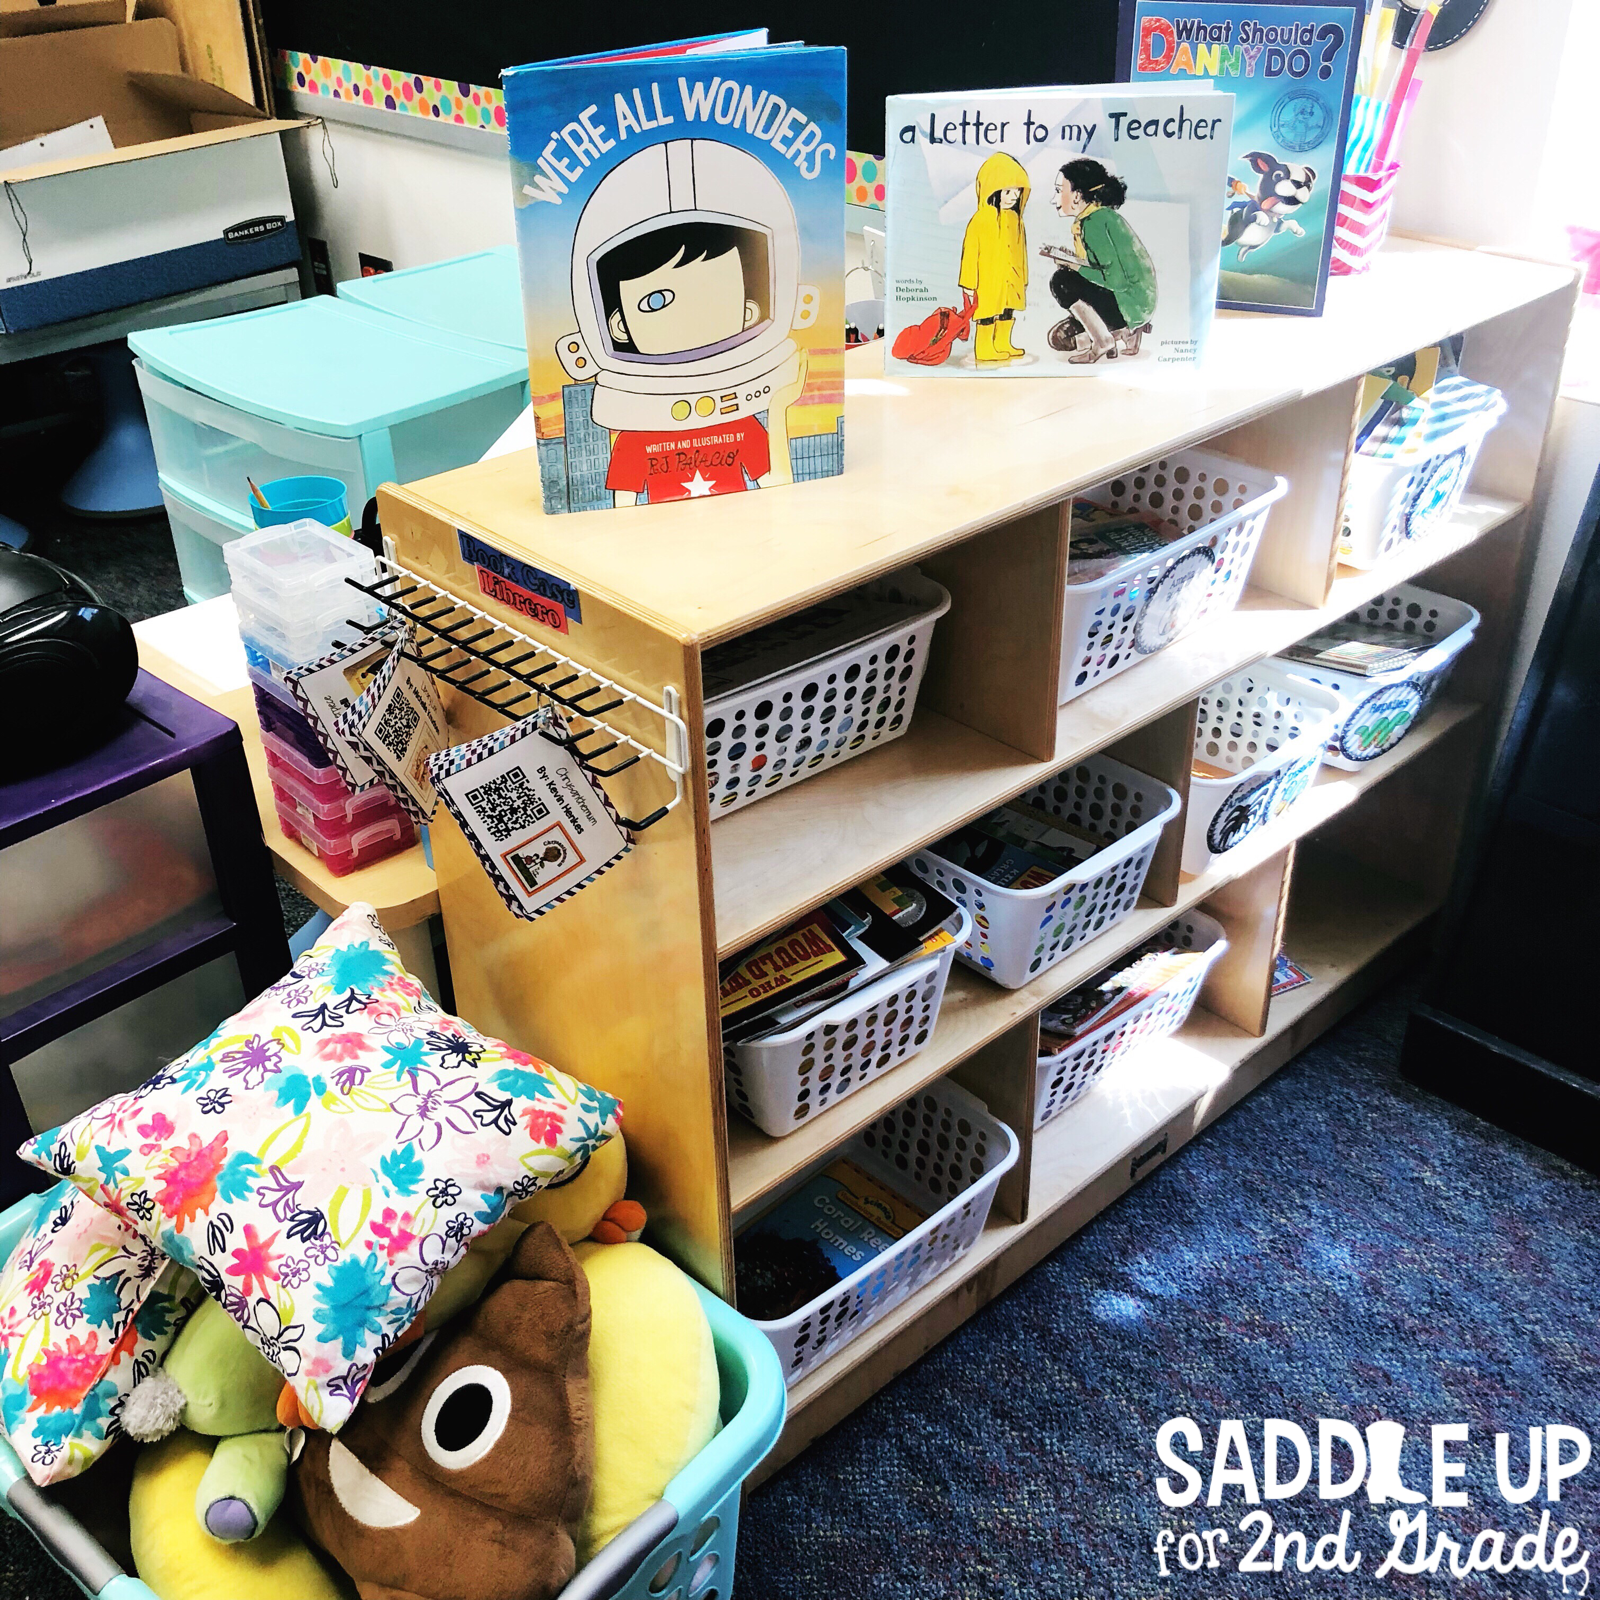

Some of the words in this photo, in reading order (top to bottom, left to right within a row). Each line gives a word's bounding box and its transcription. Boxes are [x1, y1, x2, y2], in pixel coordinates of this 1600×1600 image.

[1137, 16, 1263, 77] DANNY
[1264, 22, 1345, 81] DO?
[1174, 18, 1232, 42] What
[1239, 20, 1316, 46] Should
[522, 104, 616, 205] WE'RE
[614, 83, 674, 140] ALL
[678, 77, 836, 180] WONDERS
[900, 124, 916, 144] a
[928, 110, 1010, 144] Letter
[1023, 109, 1048, 145] to
[1061, 124, 1097, 153] my
[1108, 105, 1222, 142] Teacher
[227, 224, 265, 239] BANKERS
[265, 220, 283, 230] BOX
[895, 295, 938, 303] Hopkinson
[645, 441, 676, 454] WRITTEN
[677, 439, 691, 450] AND
[692, 433, 735, 448] ILLUSTRATED
[736, 432, 745, 441] BY
[460, 534, 518, 583] Book
[521, 564, 576, 609] Case
[479, 569, 562, 628] Librero
[536, 765, 550, 782] By:
[547, 780, 565, 809] Kevin
[560, 800, 585, 835] Henkes
[555, 767, 598, 826] Chrysanthemum
[999, 867, 1021, 888] KILL
[750, 927, 836, 981] WOULD
[748, 973, 792, 999] WHO
[813, 1195, 858, 1232] Coral
[859, 1228, 891, 1254] Ree
[863, 1195, 894, 1223] Science
[810, 1218, 865, 1263] Homes
